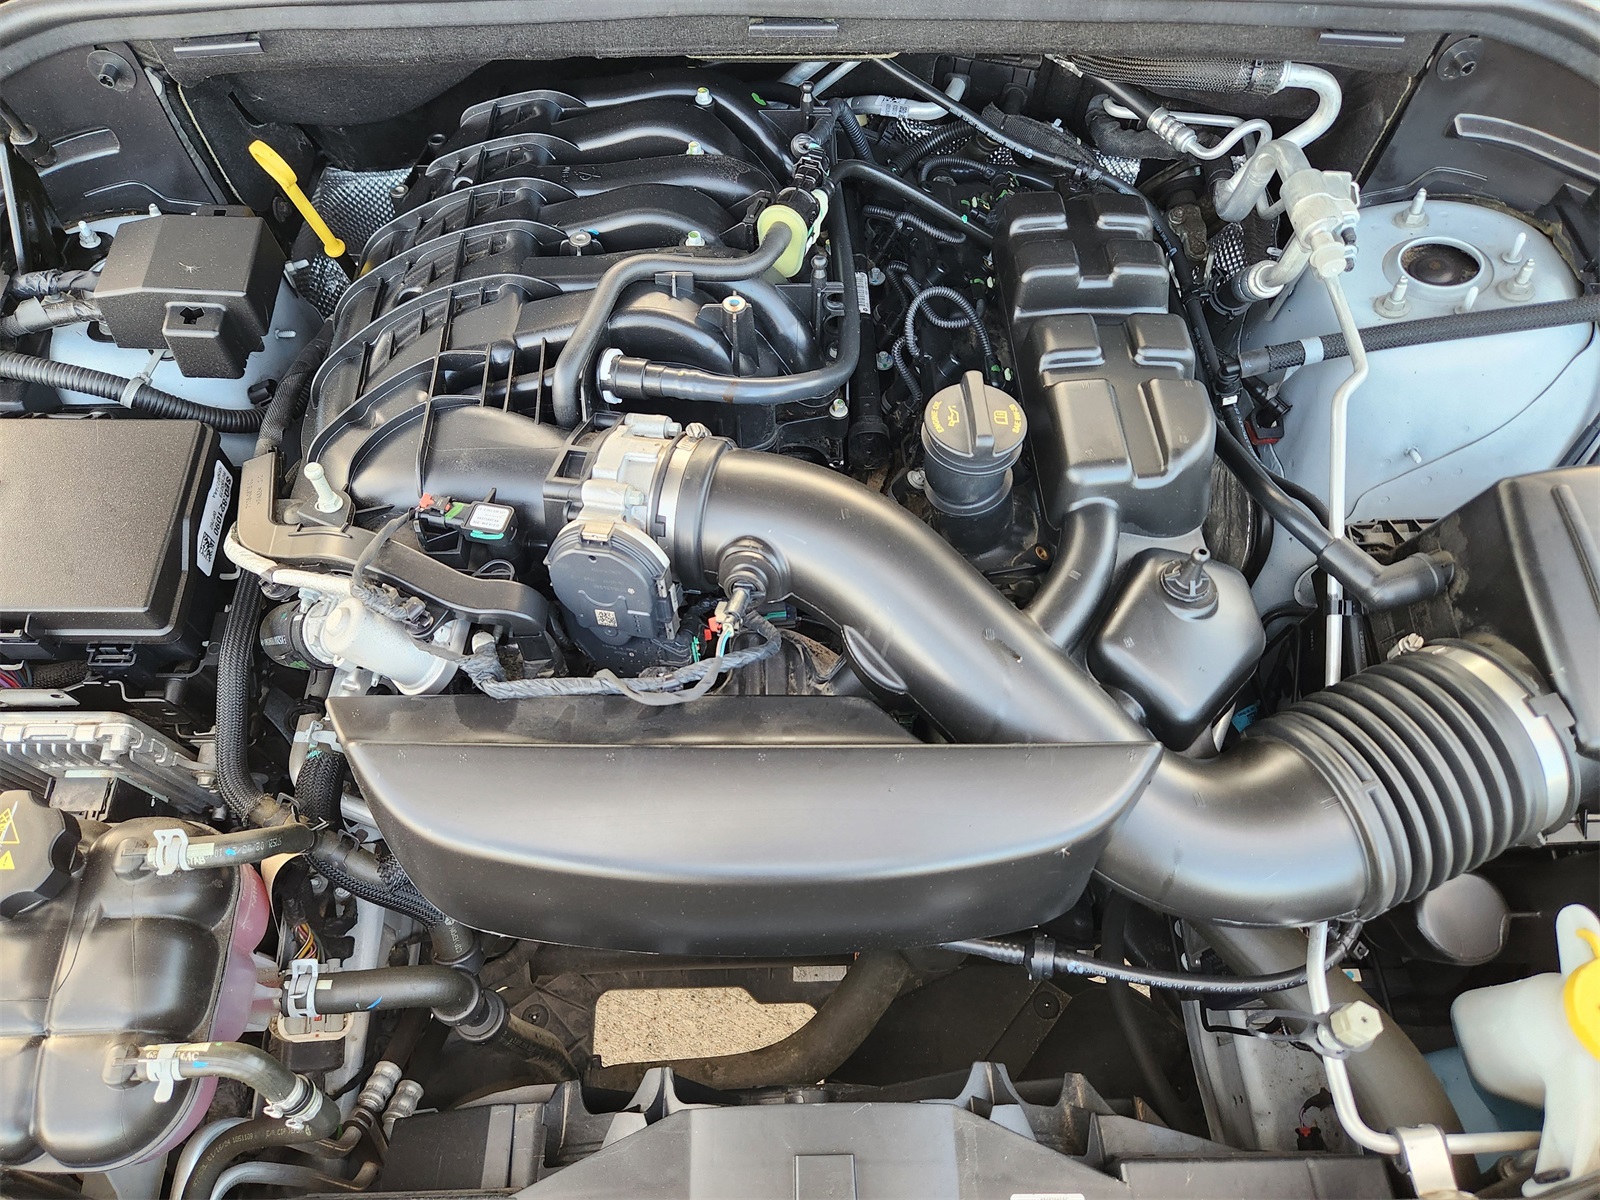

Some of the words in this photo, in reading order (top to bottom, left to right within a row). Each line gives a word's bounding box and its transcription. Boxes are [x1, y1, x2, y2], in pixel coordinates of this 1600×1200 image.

[932, 400, 942, 410] OIL
[931, 411, 944, 433] ENGINE
[1118, 974, 1147, 985] BRAKE
